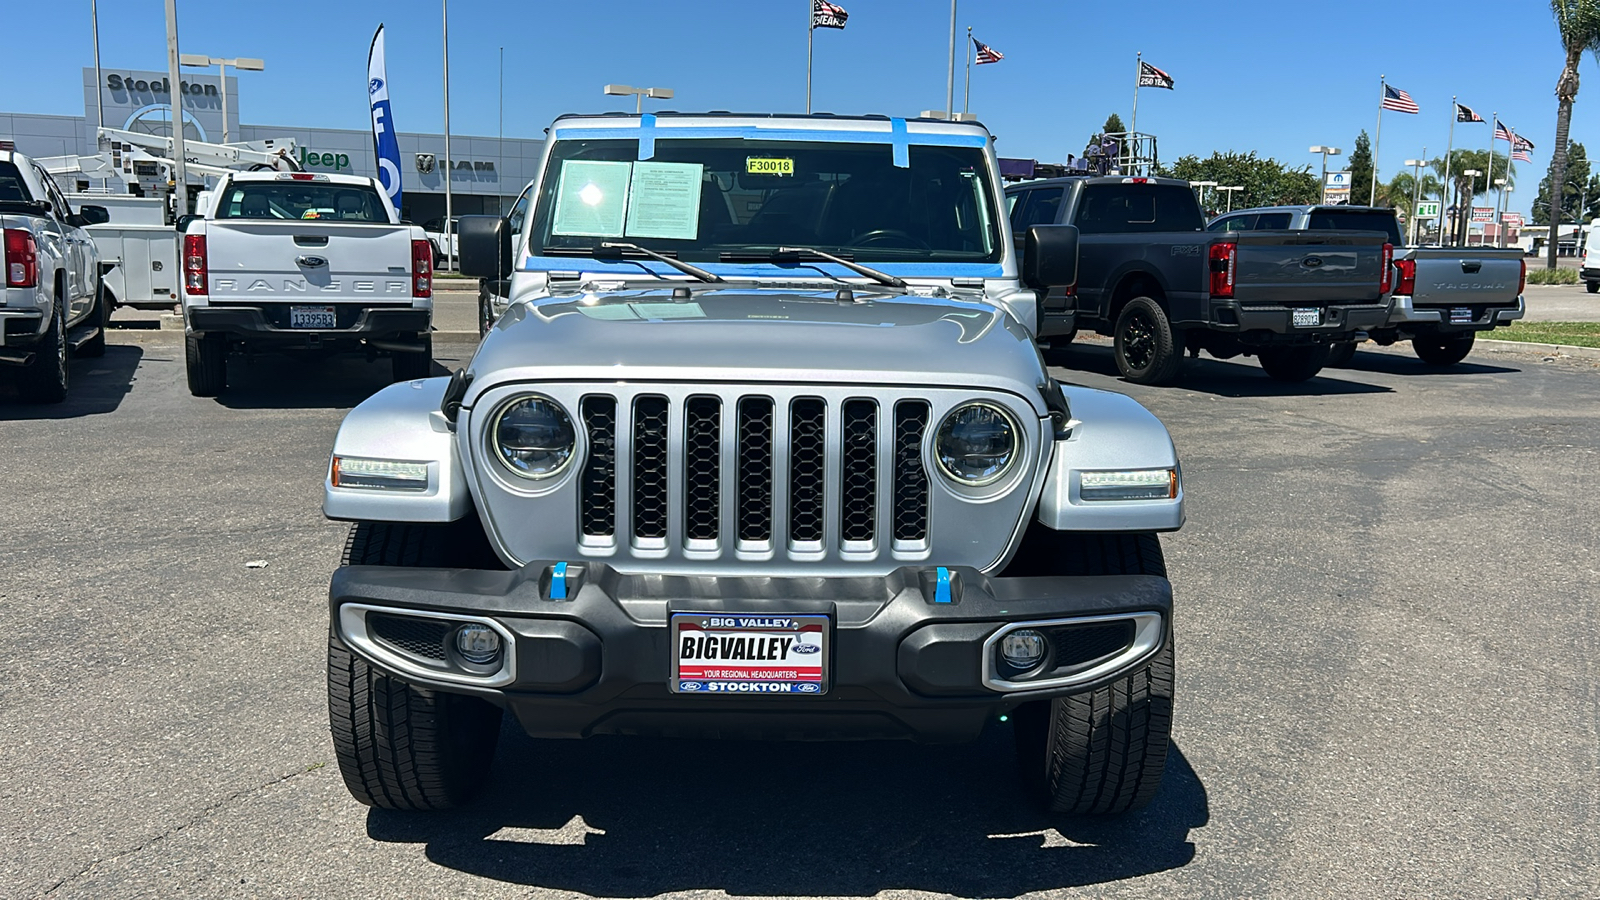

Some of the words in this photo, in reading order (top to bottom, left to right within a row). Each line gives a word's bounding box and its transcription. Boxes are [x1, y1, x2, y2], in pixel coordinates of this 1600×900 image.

[107, 74, 217, 96] Stockton
[297, 147, 349, 170] Jeep
[439, 160, 494, 171] RAM
[750, 161, 789, 171] F30018
[1171, 246, 1199, 256] FX4
[215, 279, 407, 292] RANGER
[294, 314, 333, 325] 13395B3
[710, 618, 736, 627] BIG
[740, 618, 791, 628] VALLEY
[681, 636, 793, 660] BIGVALLEY
[796, 645, 816, 653] Ford
[704, 669, 721, 678] YOUR
[721, 670, 750, 678] REGIONAL
[751, 670, 798, 679] HEADQUARTERS
[708, 682, 791, 692] STOCKTON
